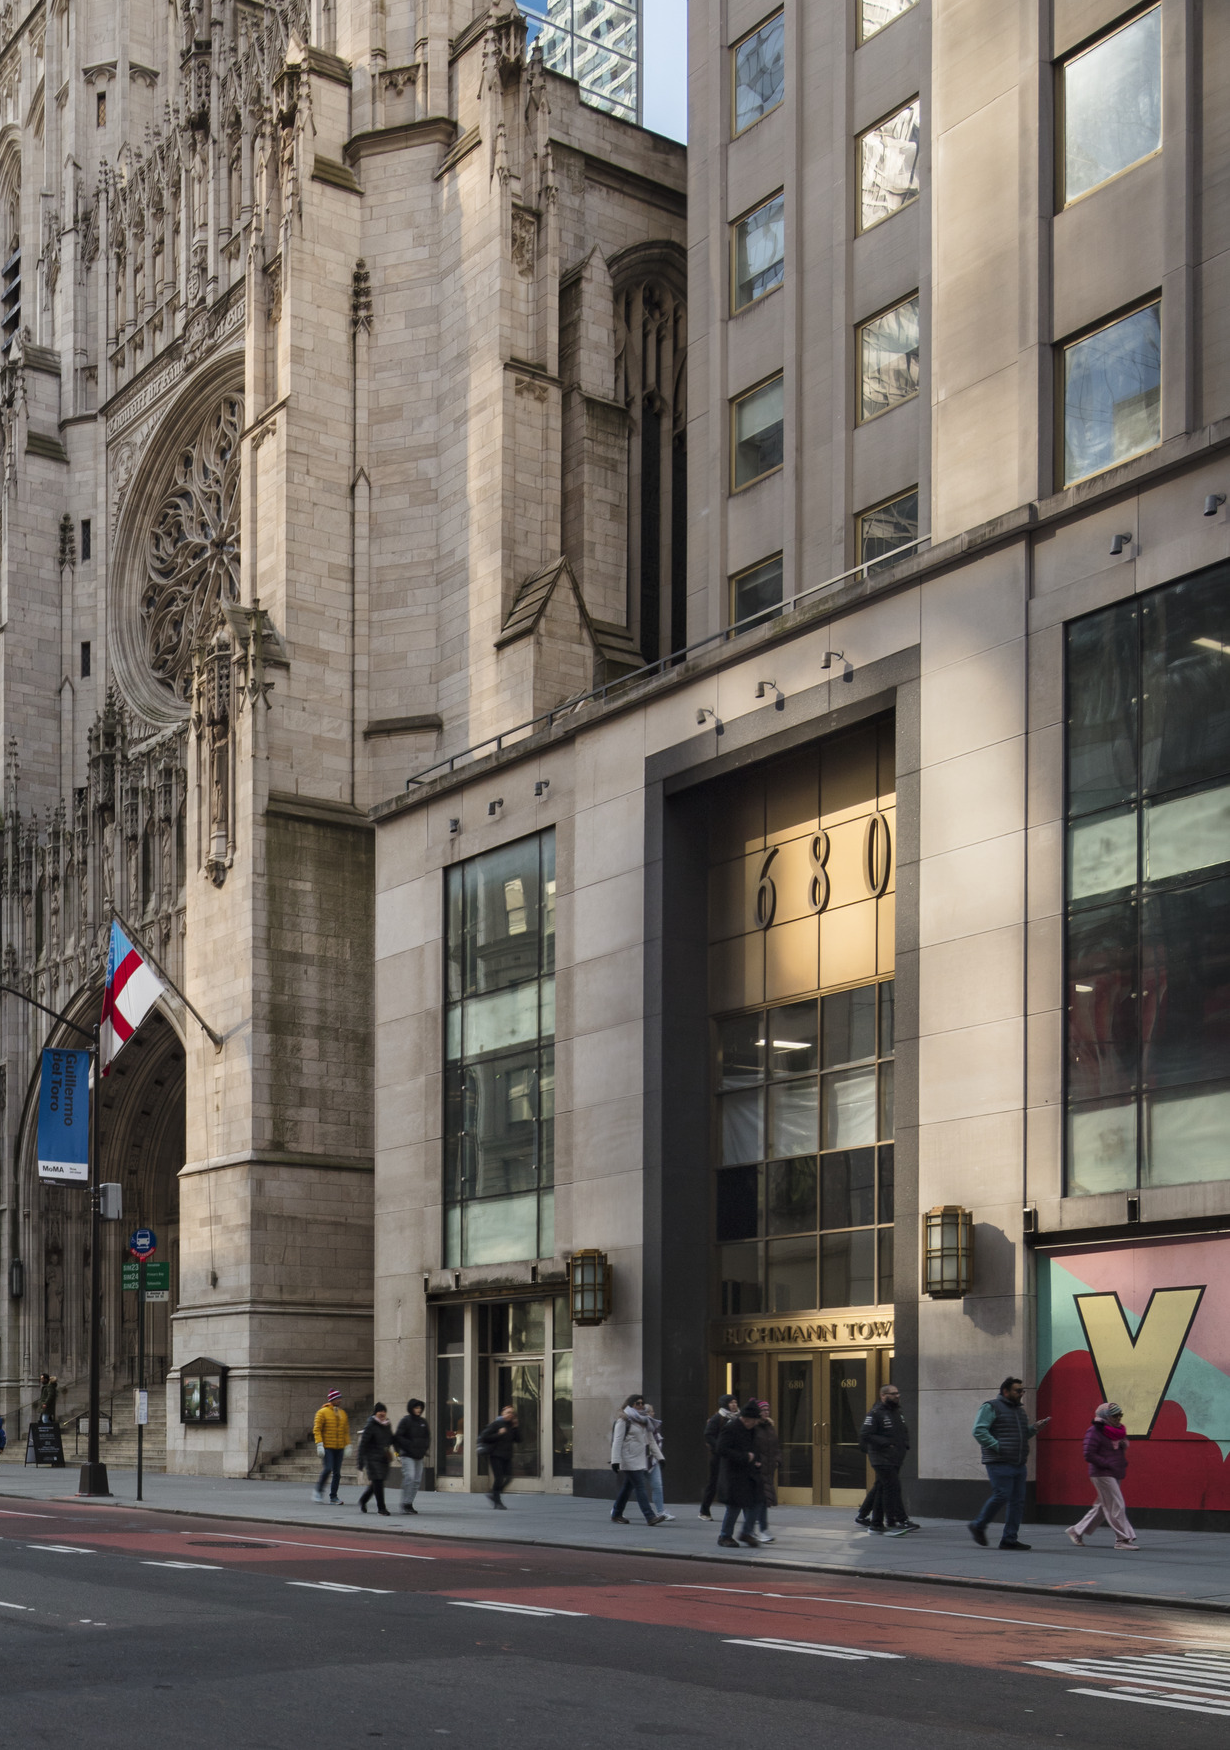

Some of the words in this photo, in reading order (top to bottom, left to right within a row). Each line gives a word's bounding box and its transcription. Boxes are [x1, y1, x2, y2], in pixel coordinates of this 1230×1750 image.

[754, 810, 892, 931] 680
[52, 1052, 64, 1076] del
[49, 1078, 63, 1112] Toro
[63, 1053, 77, 1127] Guillermo
[42, 1165, 65, 1173] MoMA
[724, 1323, 838, 1344] BUCHMANN
[843, 1320, 894, 1341] TOW
[1073, 1284, 1207, 1440] V
[788, 1380, 804, 1389] 680
[841, 1378, 857, 1388] 680
